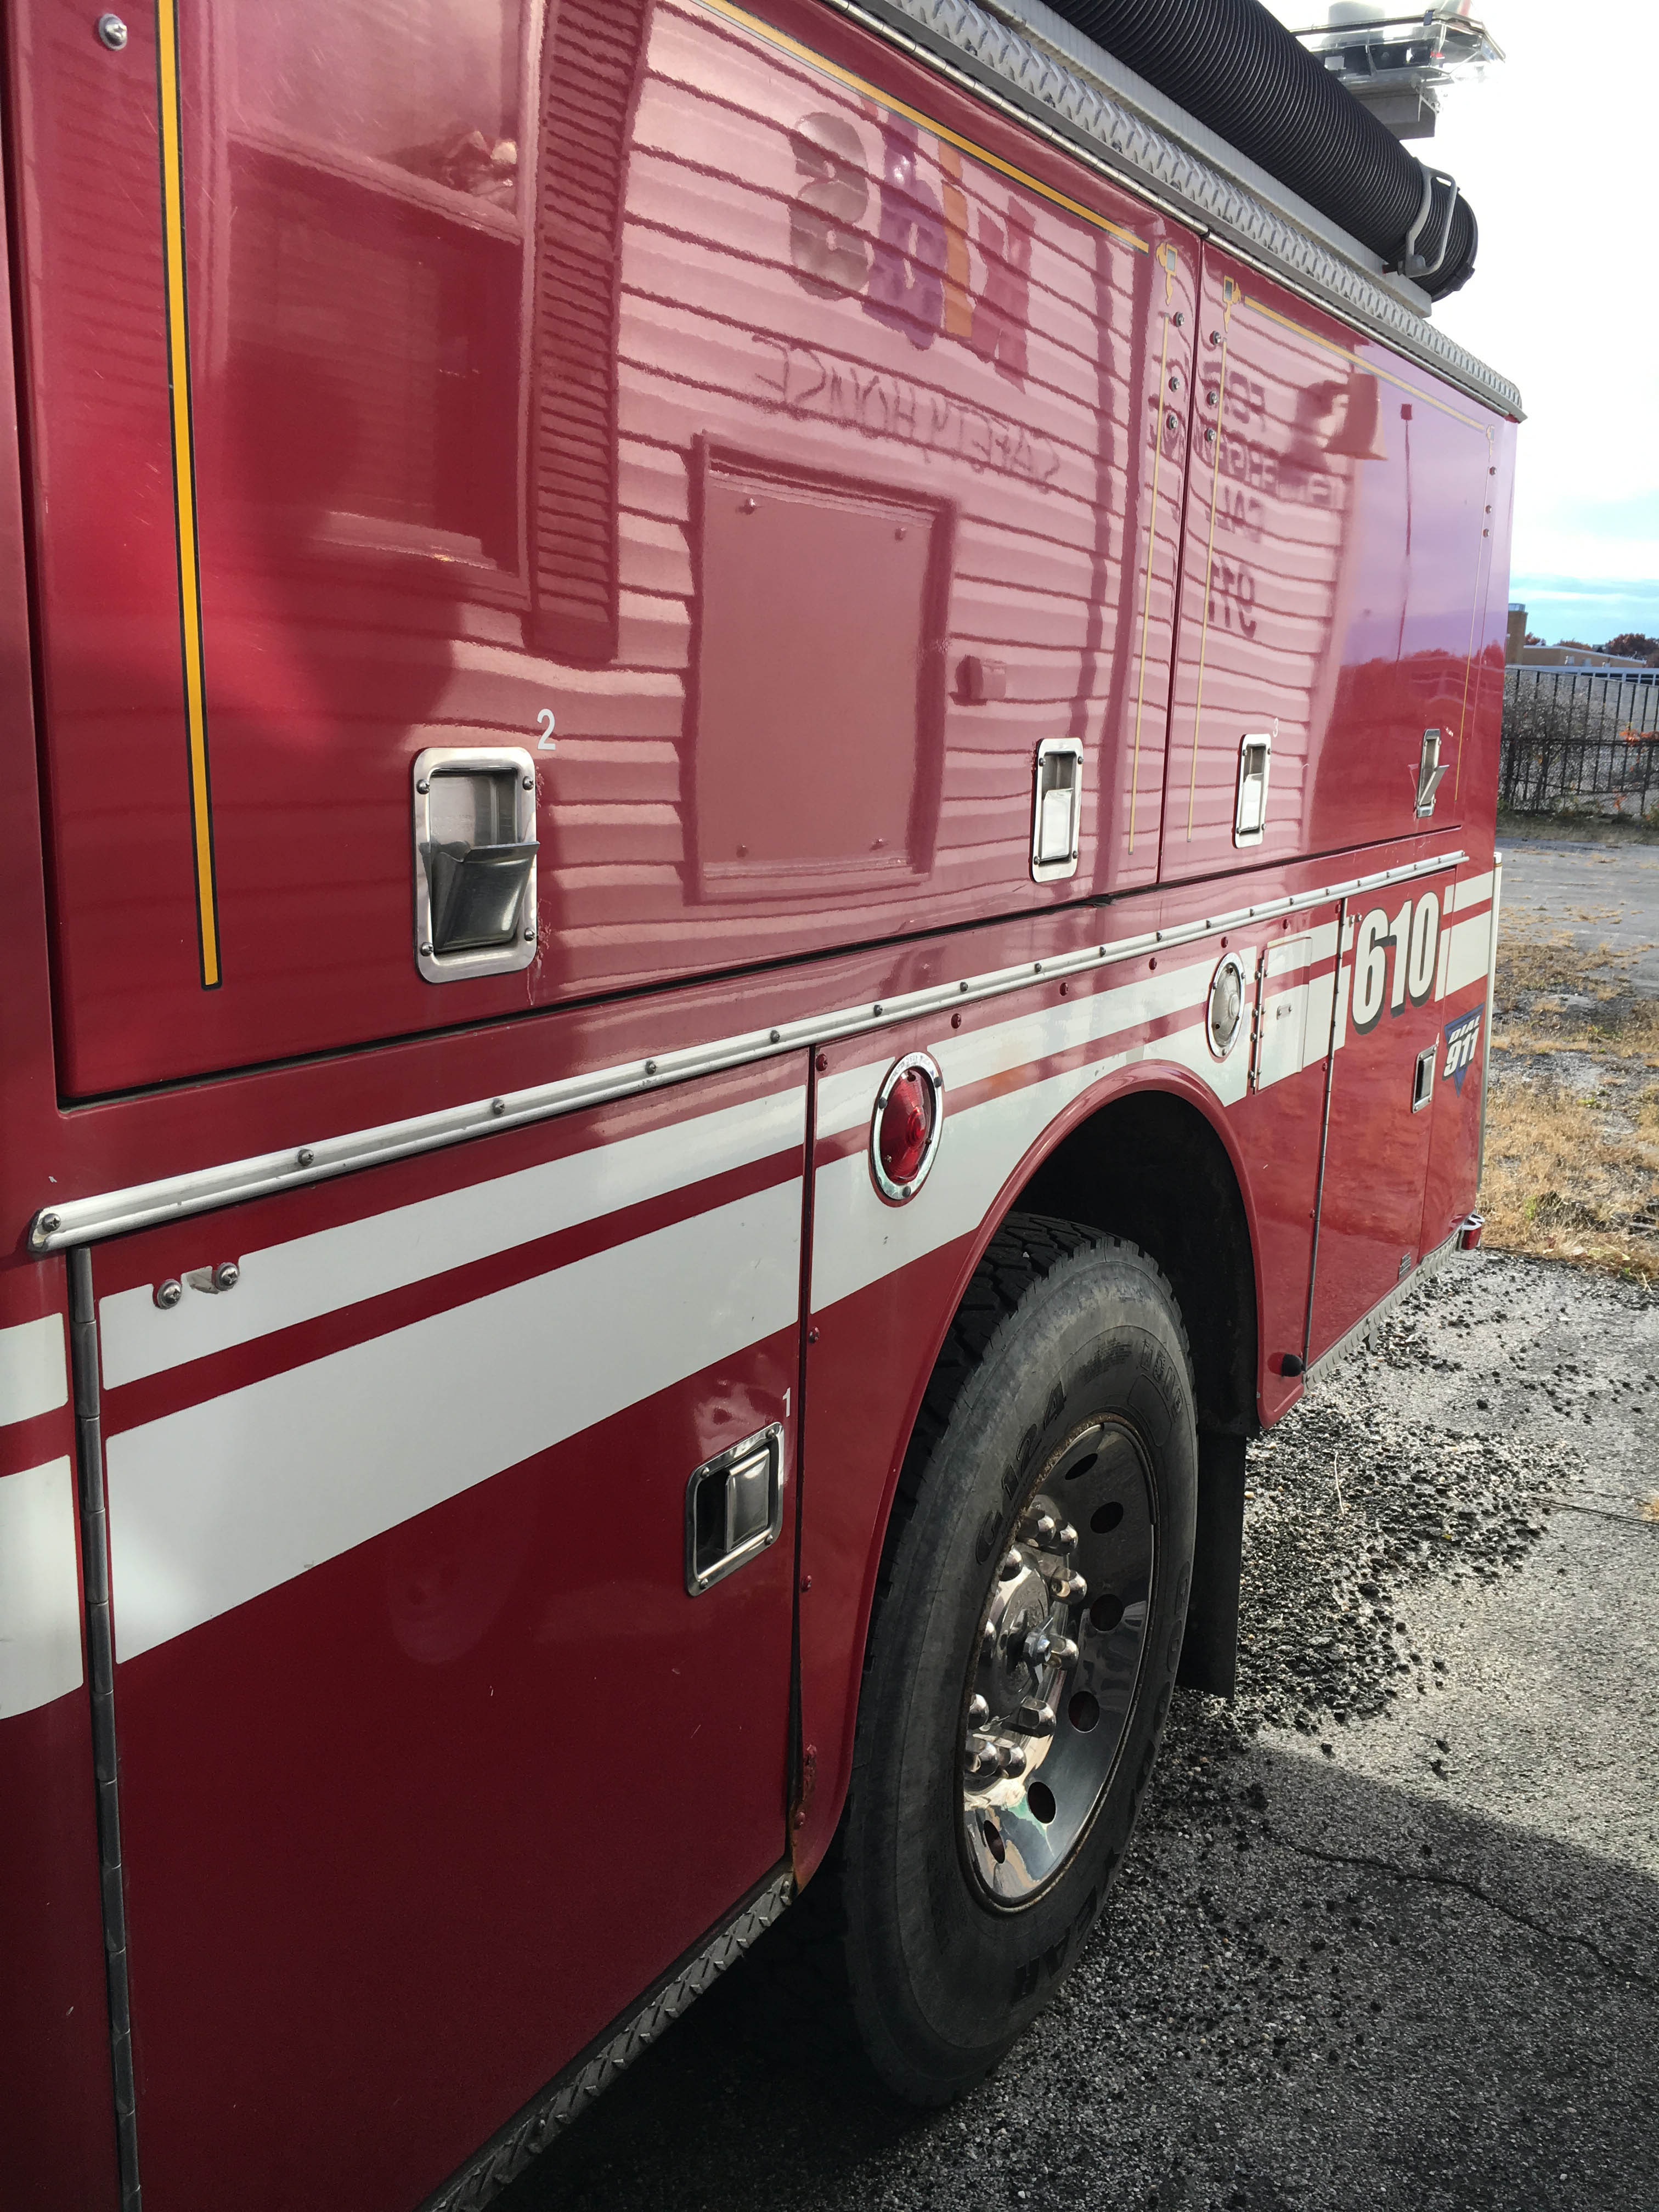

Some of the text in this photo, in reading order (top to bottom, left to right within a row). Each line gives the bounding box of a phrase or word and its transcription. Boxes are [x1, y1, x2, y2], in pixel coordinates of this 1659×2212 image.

[537, 708, 556, 751] 2
[1272, 717, 1279, 738] 3
[1351, 891, 1441, 1034] 610
[1448, 1015, 1481, 1045] DIAL
[1443, 1026, 1480, 1078] 911
[782, 1387, 791, 1418] 1
